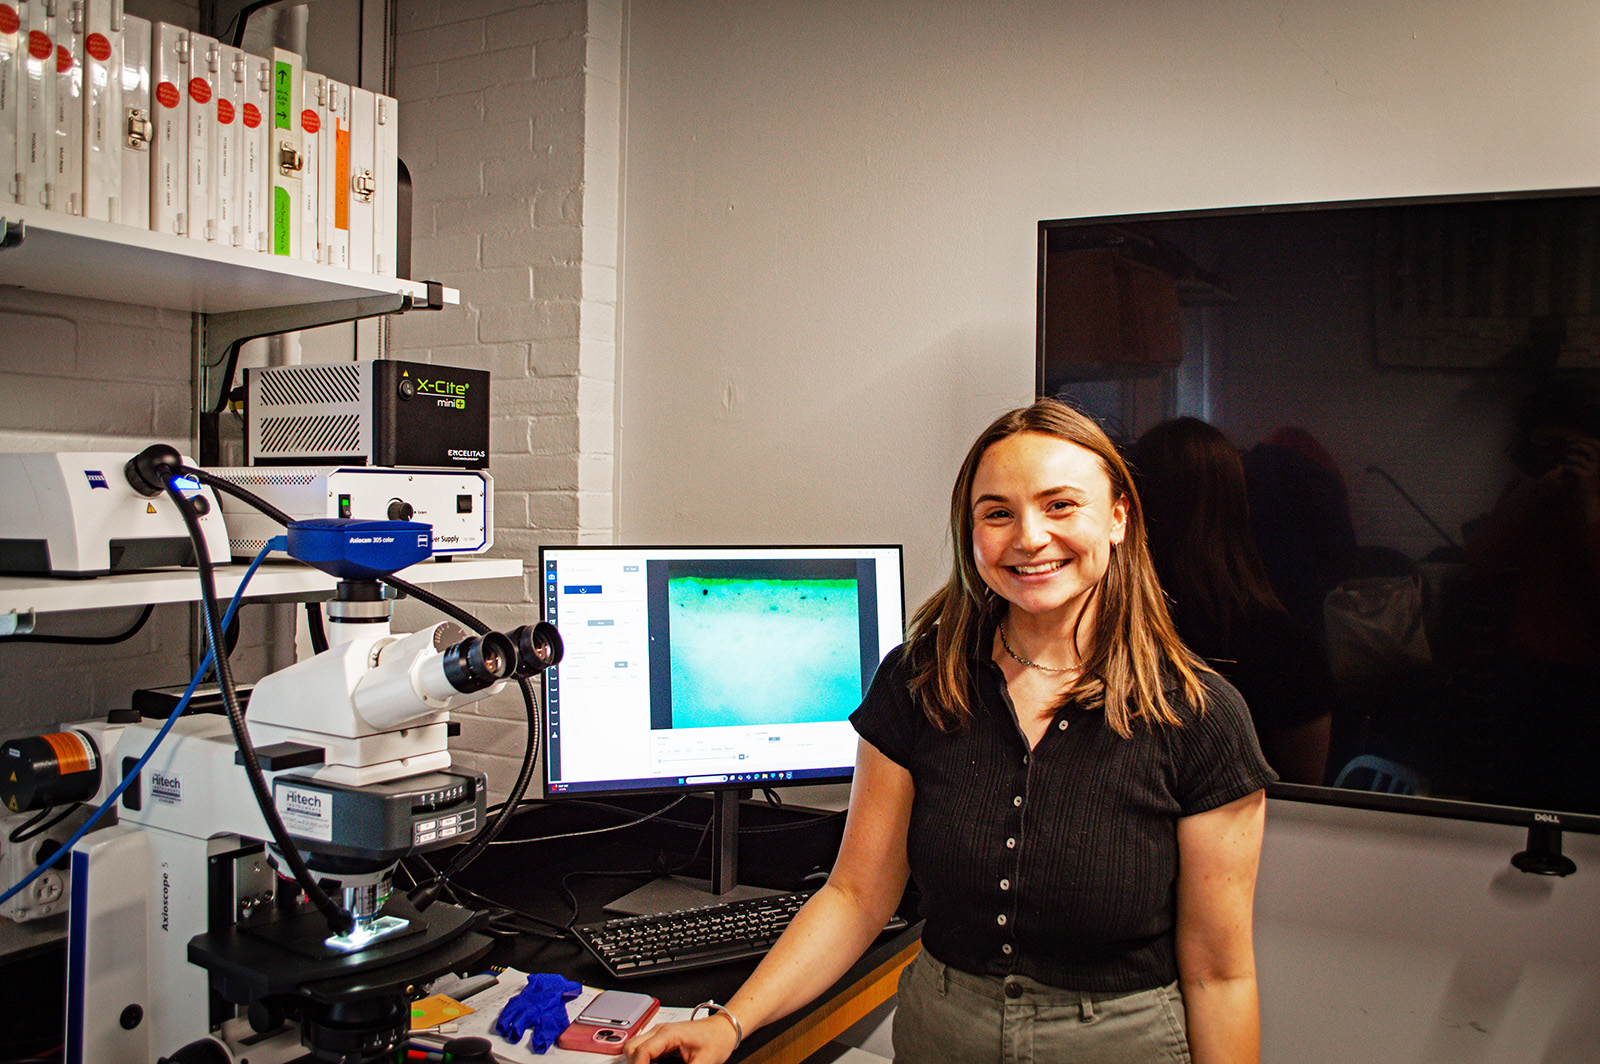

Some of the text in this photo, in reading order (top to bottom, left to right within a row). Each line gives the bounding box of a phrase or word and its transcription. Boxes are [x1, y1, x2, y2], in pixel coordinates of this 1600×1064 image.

[417, 378, 466, 395] X-Cite
[447, 449, 485, 458] EXCELITAS
[373, 536, 382, 544] 305
[441, 535, 459, 543] Supply
[152, 774, 181, 789] Hitech
[287, 791, 322, 808] Hitech
[1534, 813, 1560, 824] DELL
[161, 873, 170, 932] Axioscope
